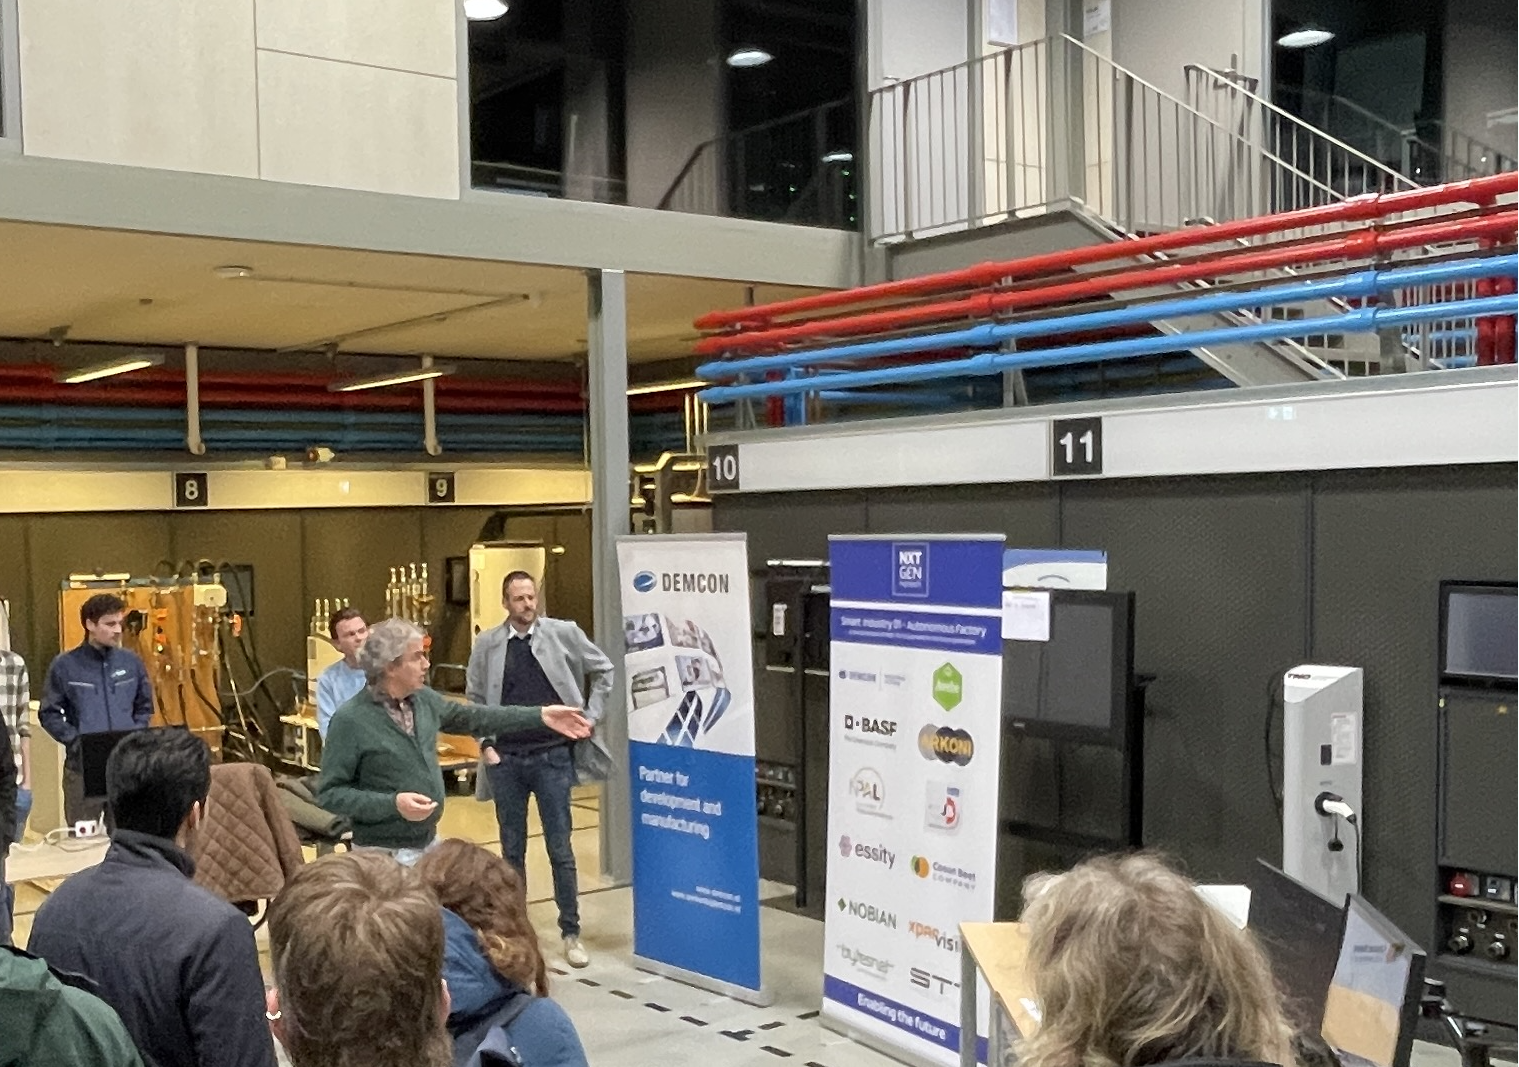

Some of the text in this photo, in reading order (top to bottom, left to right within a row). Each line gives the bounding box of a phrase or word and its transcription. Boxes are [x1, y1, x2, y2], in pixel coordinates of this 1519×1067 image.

[1060, 430, 1093, 464] 11
[712, 455, 737, 481] 10
[184, 480, 199, 500] 8
[435, 479, 448, 497] 9
[899, 550, 923, 565] NXT
[662, 573, 729, 593] DEMCON
[899, 566, 923, 580] GEN
[862, 717, 897, 736] BASF
[639, 766, 674, 784] Partner
[640, 788, 722, 816] development and
[641, 813, 710, 839] manufacturing
[855, 843, 896, 869] essity
[848, 900, 897, 930] NOBIAN
[857, 992, 947, 1041] Enabling the future
